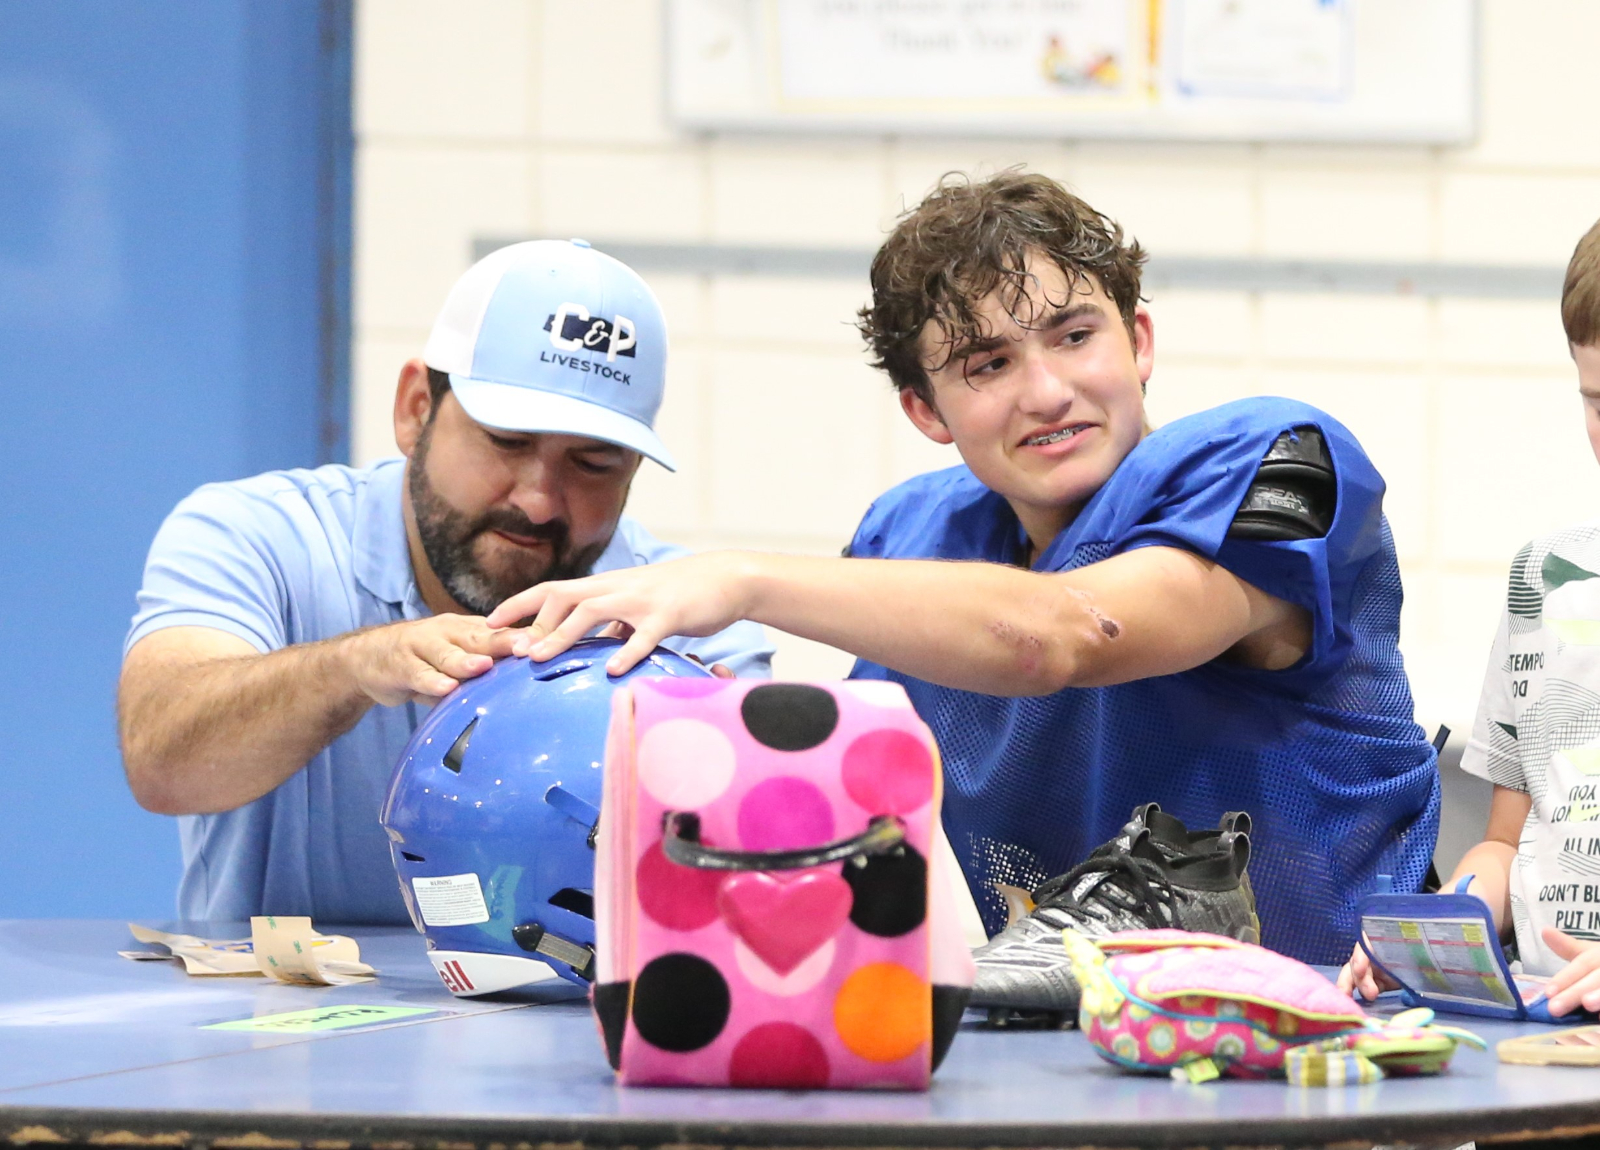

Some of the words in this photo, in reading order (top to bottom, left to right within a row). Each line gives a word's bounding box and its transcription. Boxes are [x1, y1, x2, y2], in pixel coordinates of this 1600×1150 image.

[549, 302, 636, 363] C&P
[540, 351, 632, 386] LIVESTOCK
[1539, 883, 1580, 902] DON'T
[1555, 910, 1584, 929] PUT
